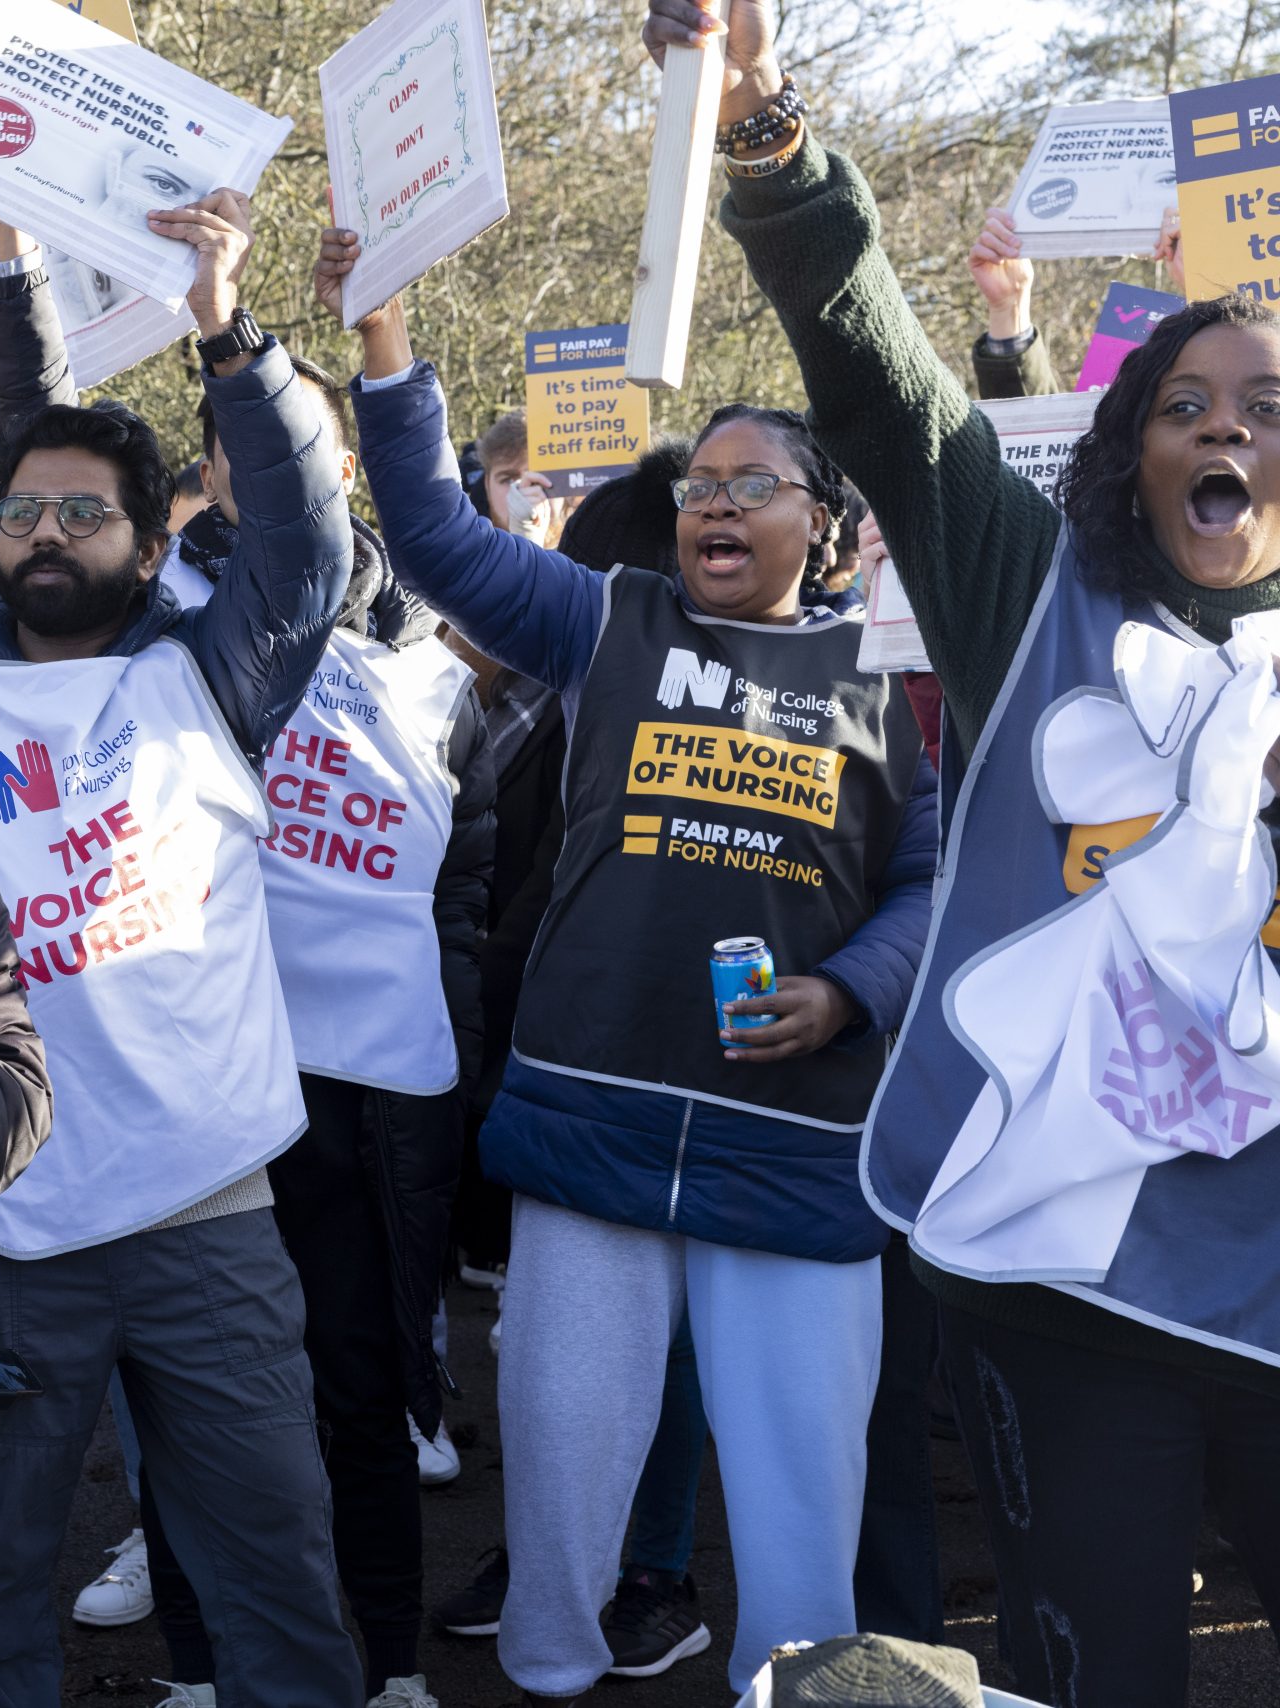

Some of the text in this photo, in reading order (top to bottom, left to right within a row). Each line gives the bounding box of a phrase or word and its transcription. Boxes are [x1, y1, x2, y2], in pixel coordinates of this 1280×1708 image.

[1, 47, 168, 135] PROTECT NURSING.
[9, 35, 170, 119] PROTECT THE NHS.
[389, 78, 419, 114] CLAPS
[9, 86, 38, 104] fight
[40, 100, 49, 109] is
[51, 107, 70, 120] our
[70, 114, 100, 134] fight
[75, 97, 107, 121] THE
[110, 116, 179, 157] PUBLIC.
[1248, 104, 1280, 127] FA
[396, 124, 425, 159] DON'T
[1049, 138, 1168, 152] PROTECT NURSING.
[1054, 126, 1168, 141] PROTECT THE NHS.
[1251, 125, 1280, 148] FO
[1044, 152, 1098, 164] PROTECT
[1102, 151, 1125, 160] THE
[14, 165, 86, 205] #FairPayForNursing
[380, 154, 450, 222] PAY OUR BILLS
[560, 337, 612, 352] FAIR PAY
[560, 349, 584, 361] FOR
[546, 376, 626, 396] It's time
[550, 416, 625, 435] nursing
[556, 399, 617, 415] to pay
[537, 434, 639, 456] staff fairly
[1006, 444, 1042, 461] THE
[313, 691, 379, 725] Nursing
[731, 697, 818, 736] of Nursing
[735, 677, 845, 718] Royal College
[84, 719, 138, 768] College
[653, 732, 830, 784] THE VOICE
[76, 755, 132, 796] Nursing
[634, 760, 834, 816] OF NURSING
[342, 792, 407, 834] OF
[48, 799, 143, 877] THE
[255, 823, 399, 881] RSING
[670, 818, 783, 854] FAIR PAY
[667, 839, 823, 888] FOR NURSING
[7, 852, 146, 940] VOICE
